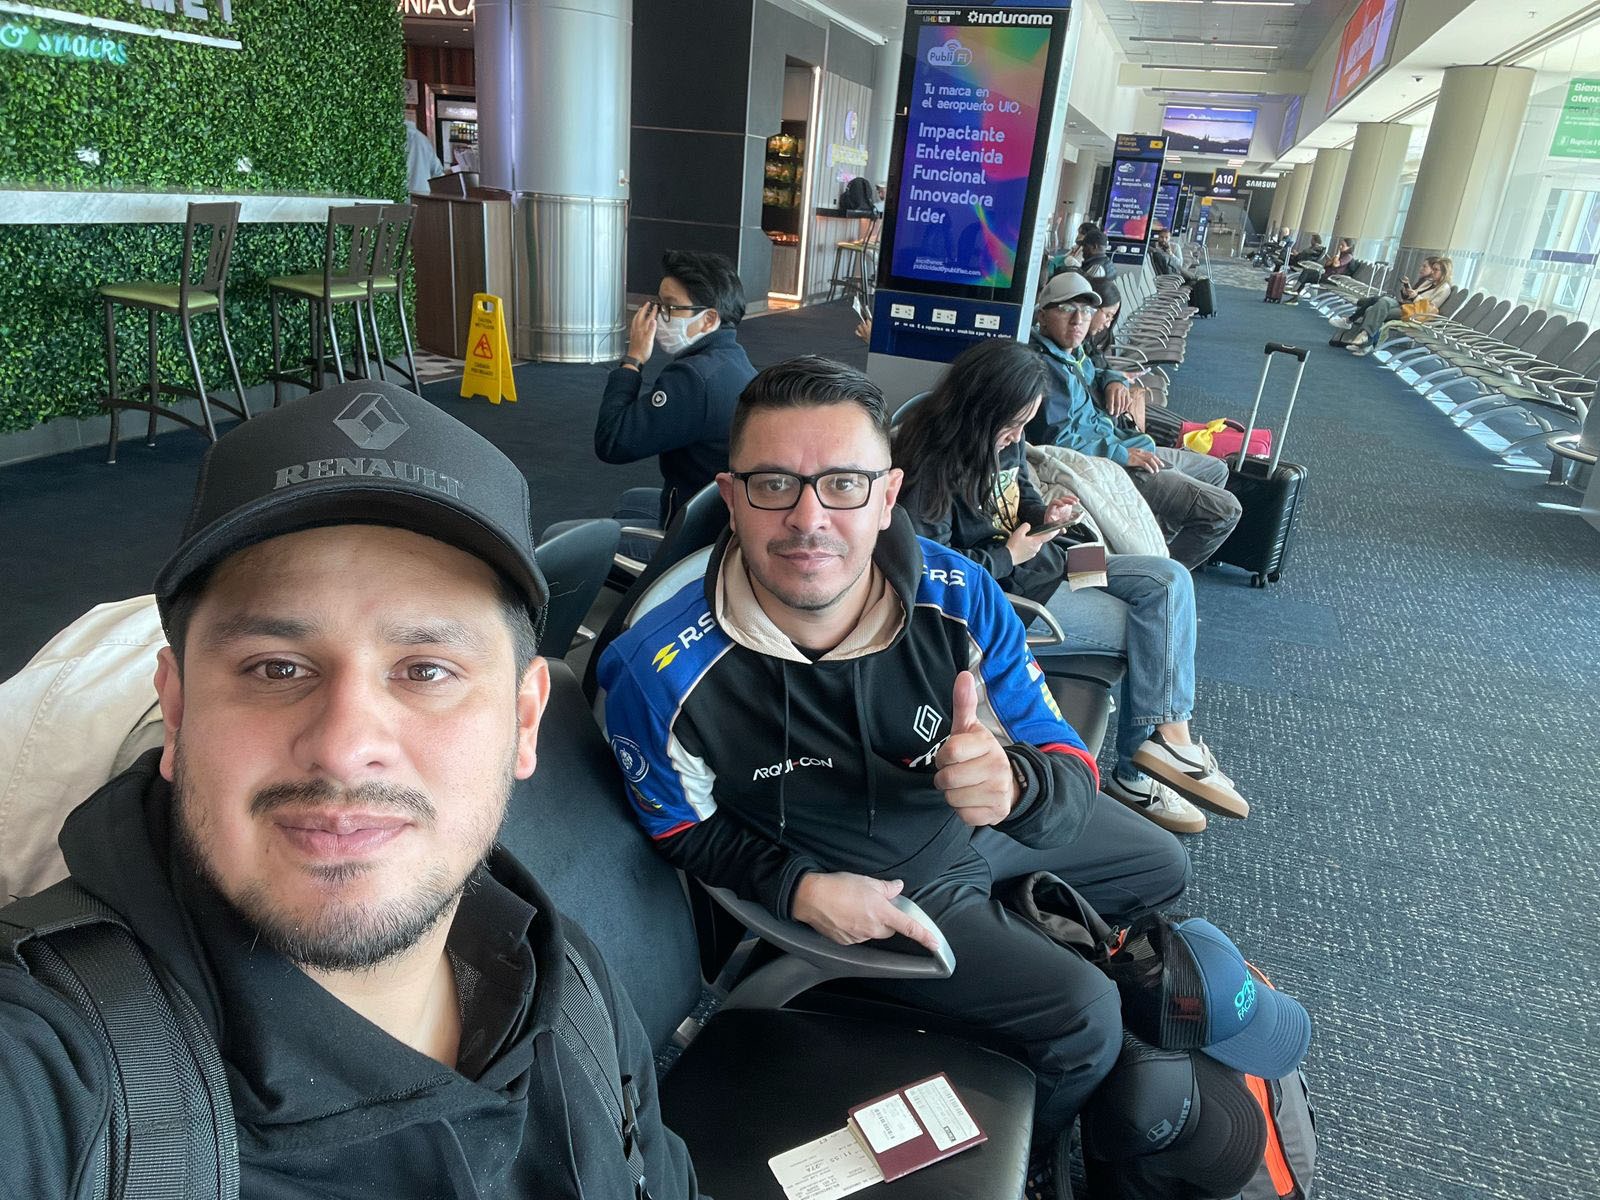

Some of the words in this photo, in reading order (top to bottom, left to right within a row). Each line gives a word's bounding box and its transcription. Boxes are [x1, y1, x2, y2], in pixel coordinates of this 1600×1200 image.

[978, 11, 1053, 25] indurama
[930, 51, 953, 62] Publi
[924, 82, 935, 95] Tu
[938, 86, 972, 96] marca
[975, 88, 990, 98] en
[921, 97, 932, 108] el
[937, 100, 994, 113] aeropuerto
[918, 122, 1005, 143] Impactante
[915, 143, 1004, 164] Entretenida
[913, 164, 987, 185] Funcional
[1216, 174, 1234, 185] A10
[910, 185, 994, 207] Innovadora
[1113, 196, 1137, 204] Aumenta
[907, 205, 946, 224] Líder
[273, 457, 460, 500] RENAULT
[677, 611, 718, 650] RS
